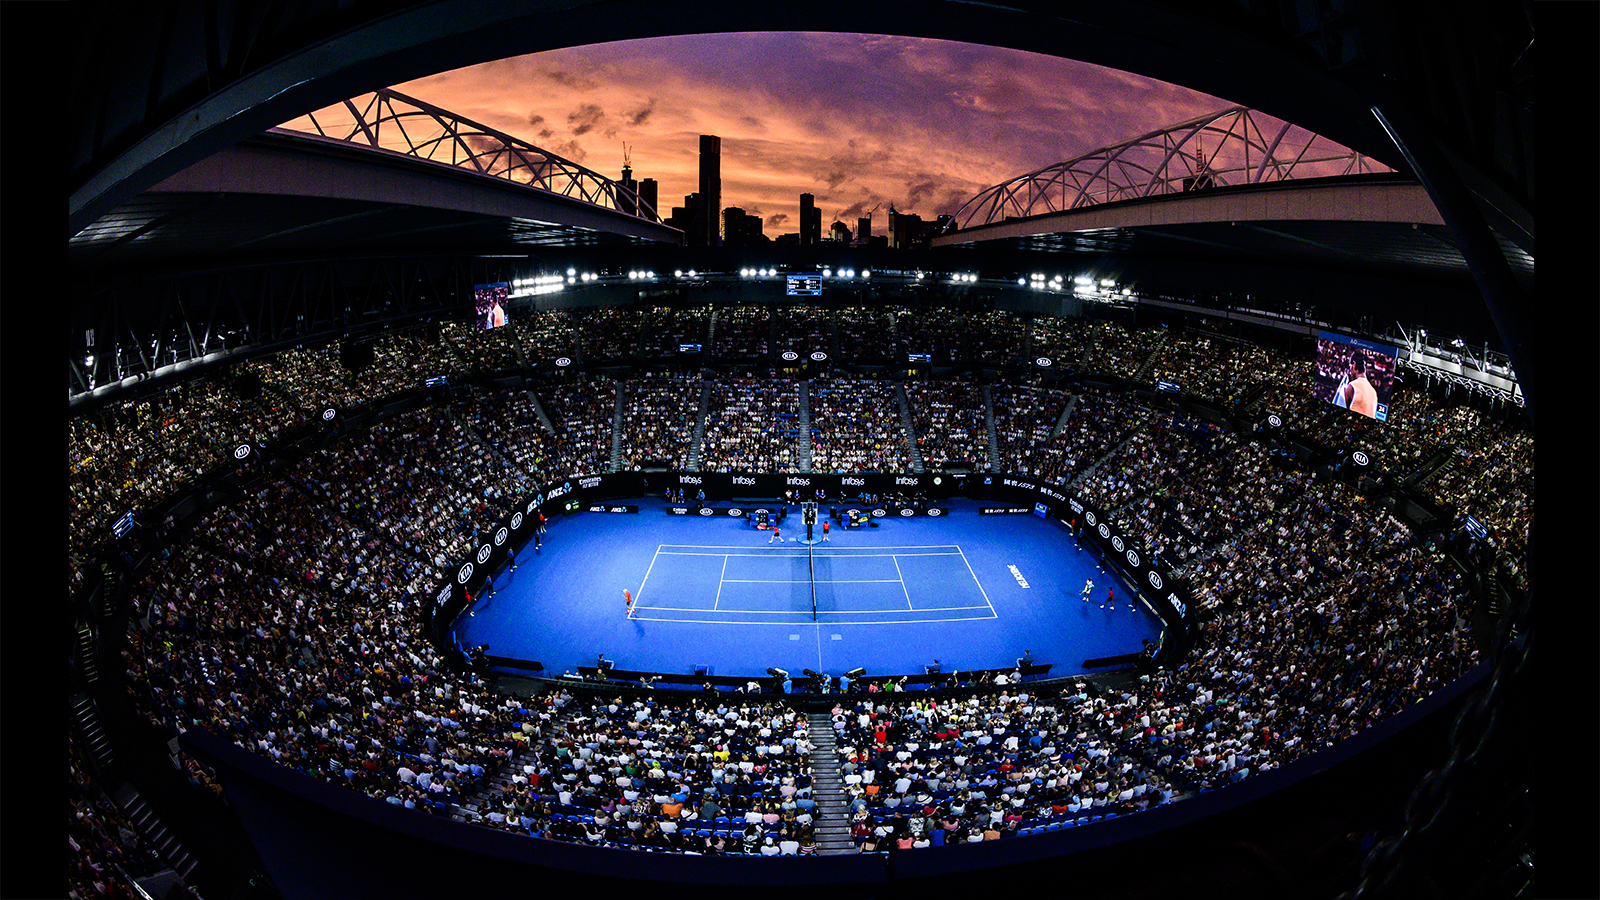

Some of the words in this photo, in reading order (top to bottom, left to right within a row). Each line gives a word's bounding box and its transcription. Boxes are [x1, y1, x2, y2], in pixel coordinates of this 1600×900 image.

[680, 476, 702, 485] Infosys
[733, 476, 755, 486] Infosys
[787, 477, 810, 486] Infosys
[842, 477, 864, 486] Infosys
[896, 477, 918, 486] Infosys
[547, 487, 564, 500] ANZ
[526, 500, 538, 514] ANZ
[1168, 593, 1181, 612] ANZ
